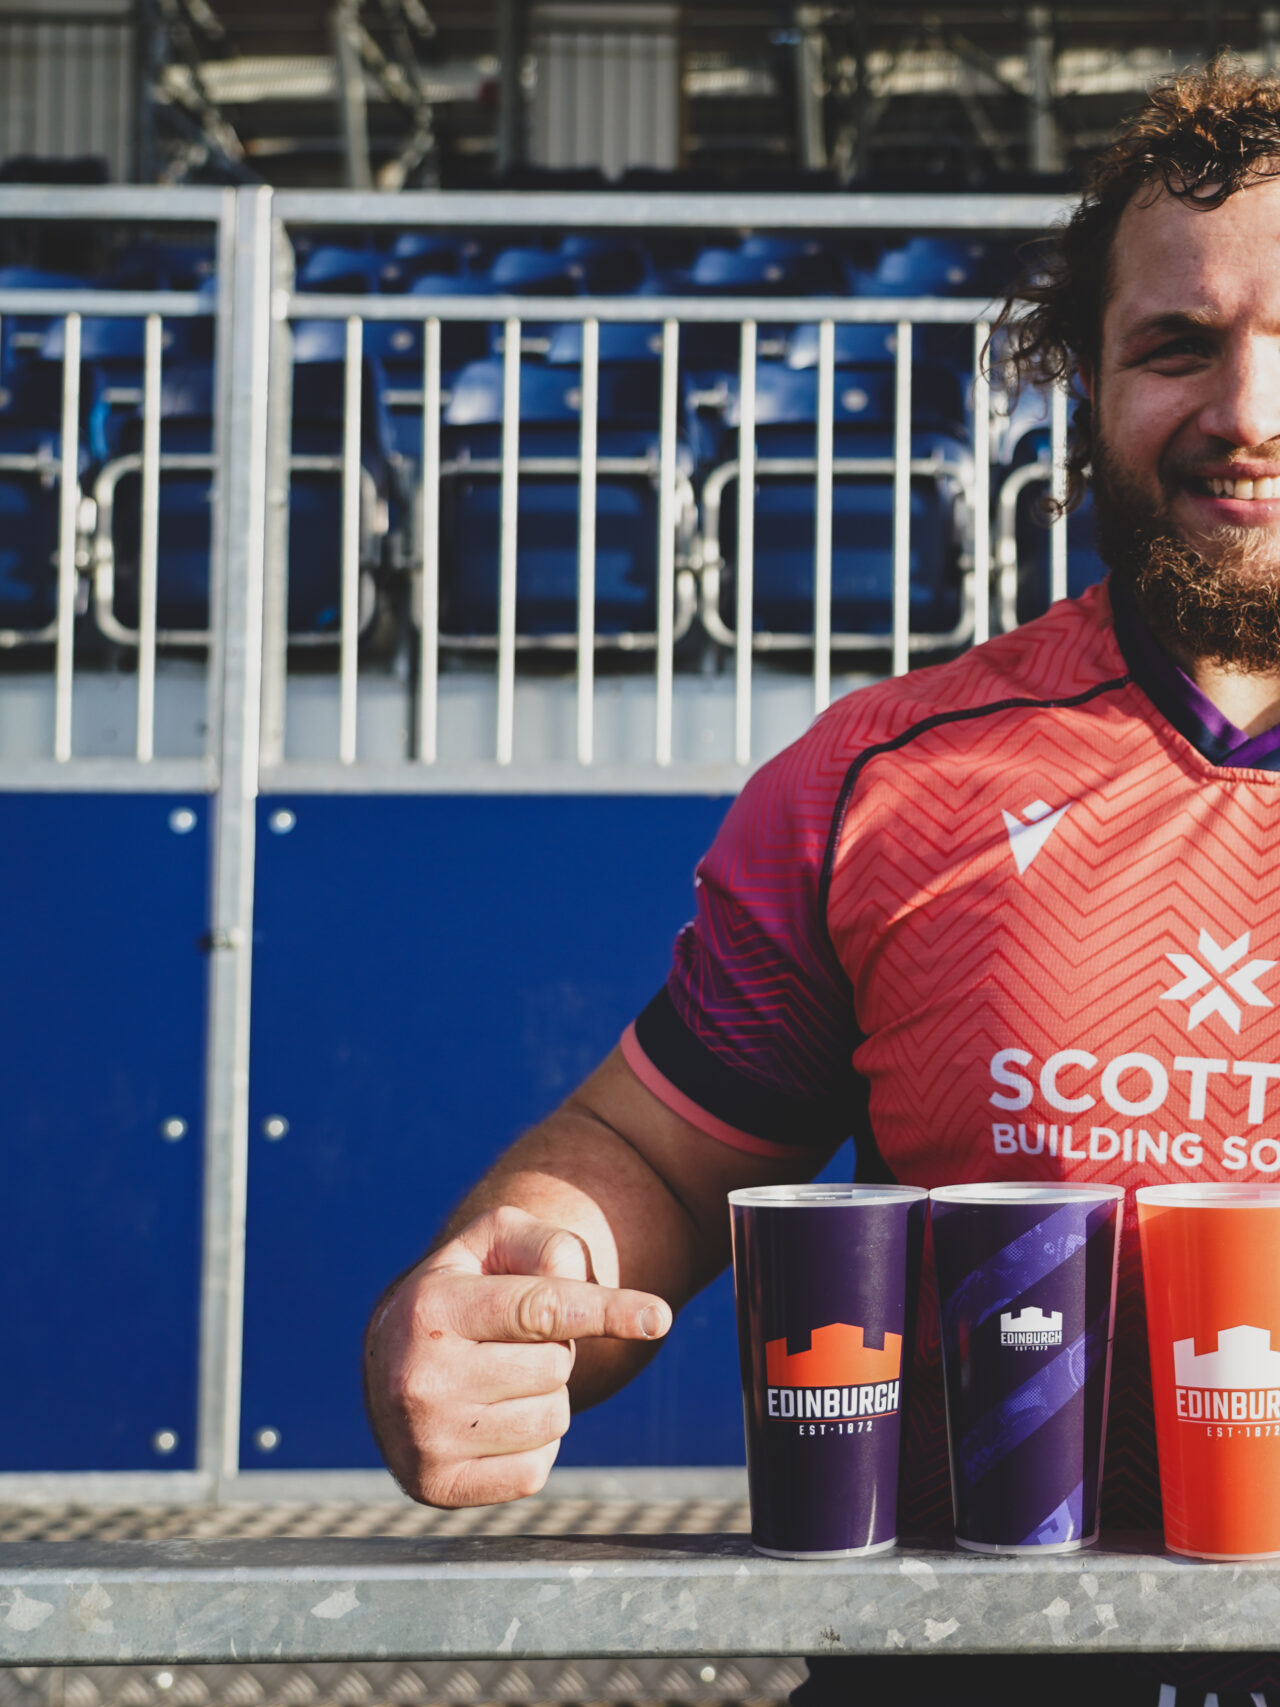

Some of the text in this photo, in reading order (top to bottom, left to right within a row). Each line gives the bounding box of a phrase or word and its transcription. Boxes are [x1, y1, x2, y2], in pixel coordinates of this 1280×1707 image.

[992, 1123, 1204, 1167] BUILDING
[1000, 1330, 1063, 1344] EDINBURGH
[767, 1380, 901, 1419] EDINBURGH
